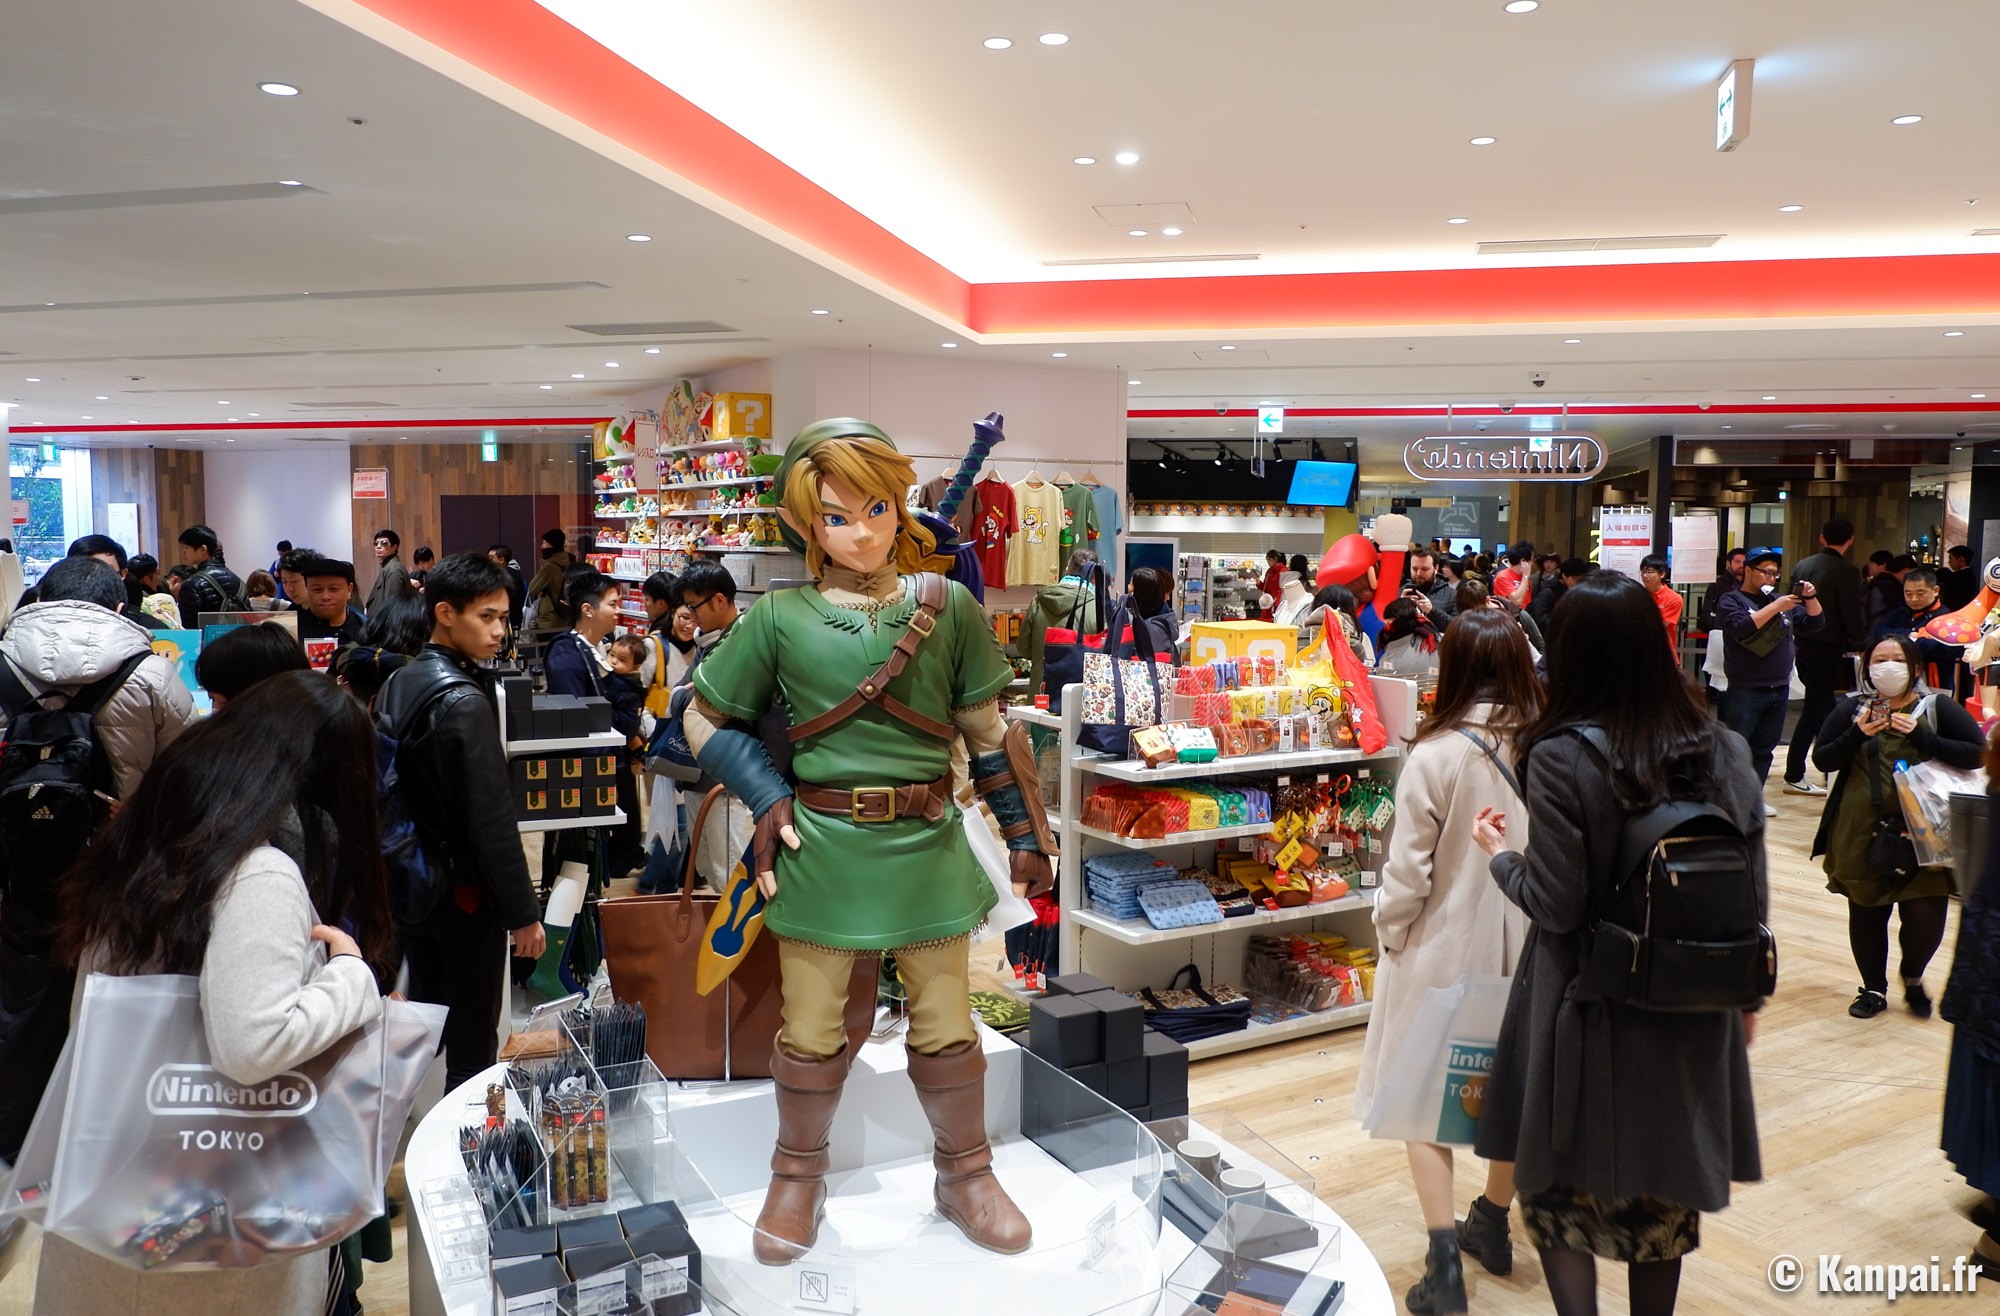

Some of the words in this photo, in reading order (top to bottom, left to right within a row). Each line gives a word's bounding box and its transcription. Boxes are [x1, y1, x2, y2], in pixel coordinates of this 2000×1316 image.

[1447, 1047, 1494, 1069] inte
[155, 1076, 302, 1106] Nintendo
[1449, 1083, 1485, 1100] TOK
[179, 1129, 264, 1151] TOKYO
